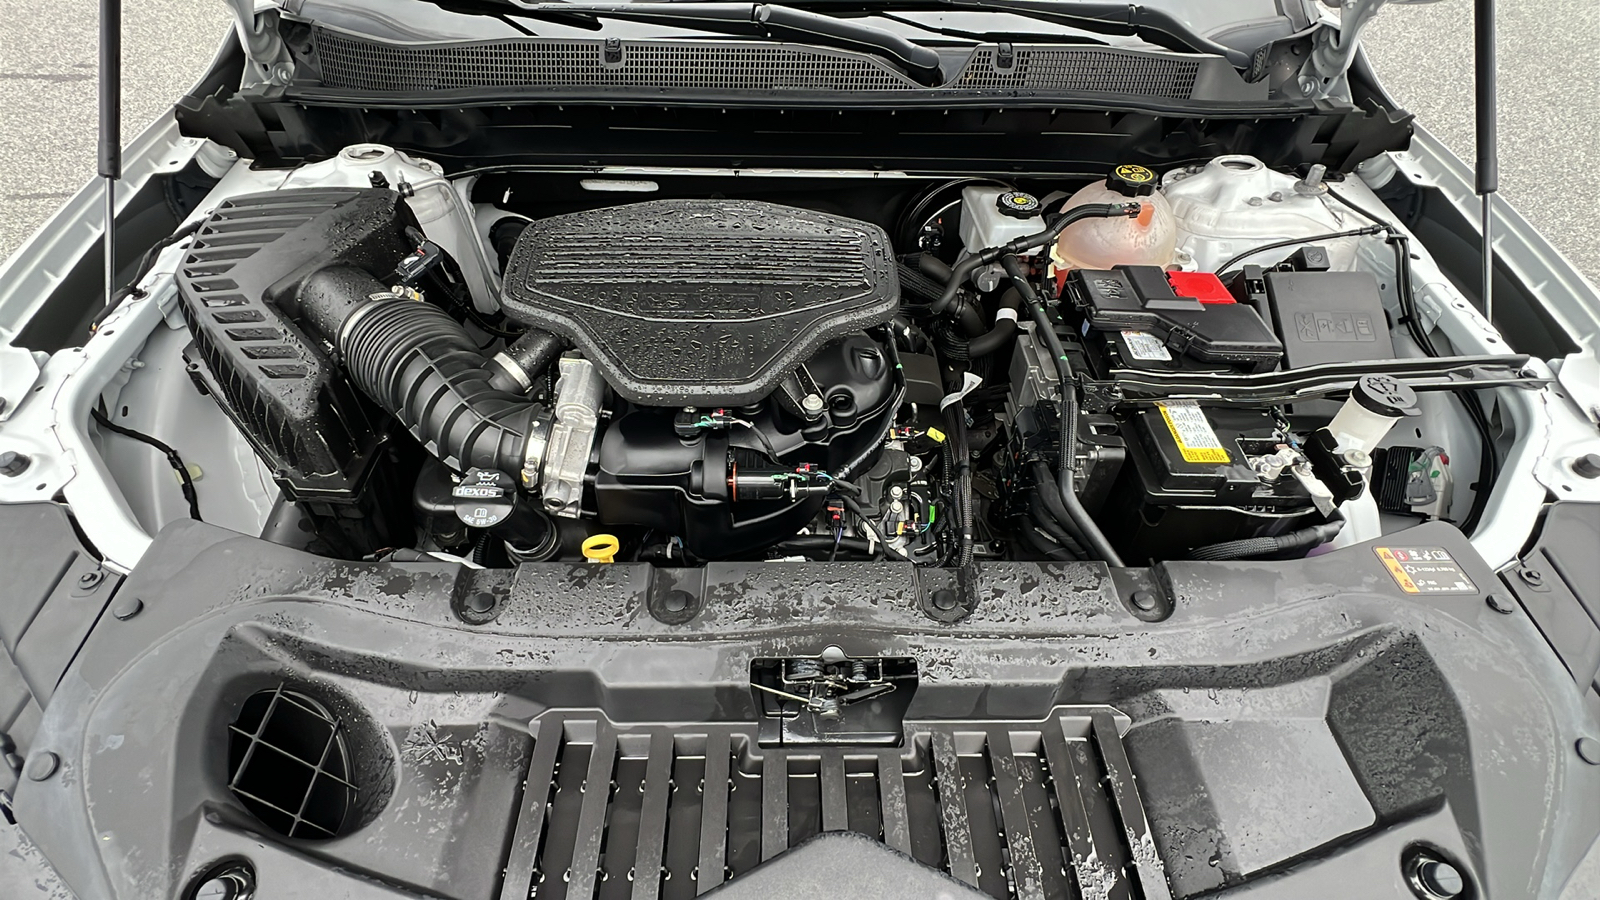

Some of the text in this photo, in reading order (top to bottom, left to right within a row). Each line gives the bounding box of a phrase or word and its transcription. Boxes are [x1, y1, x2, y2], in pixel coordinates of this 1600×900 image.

[455, 485, 500, 498] dexos
[463, 514, 498, 525] SAE 5W-30
